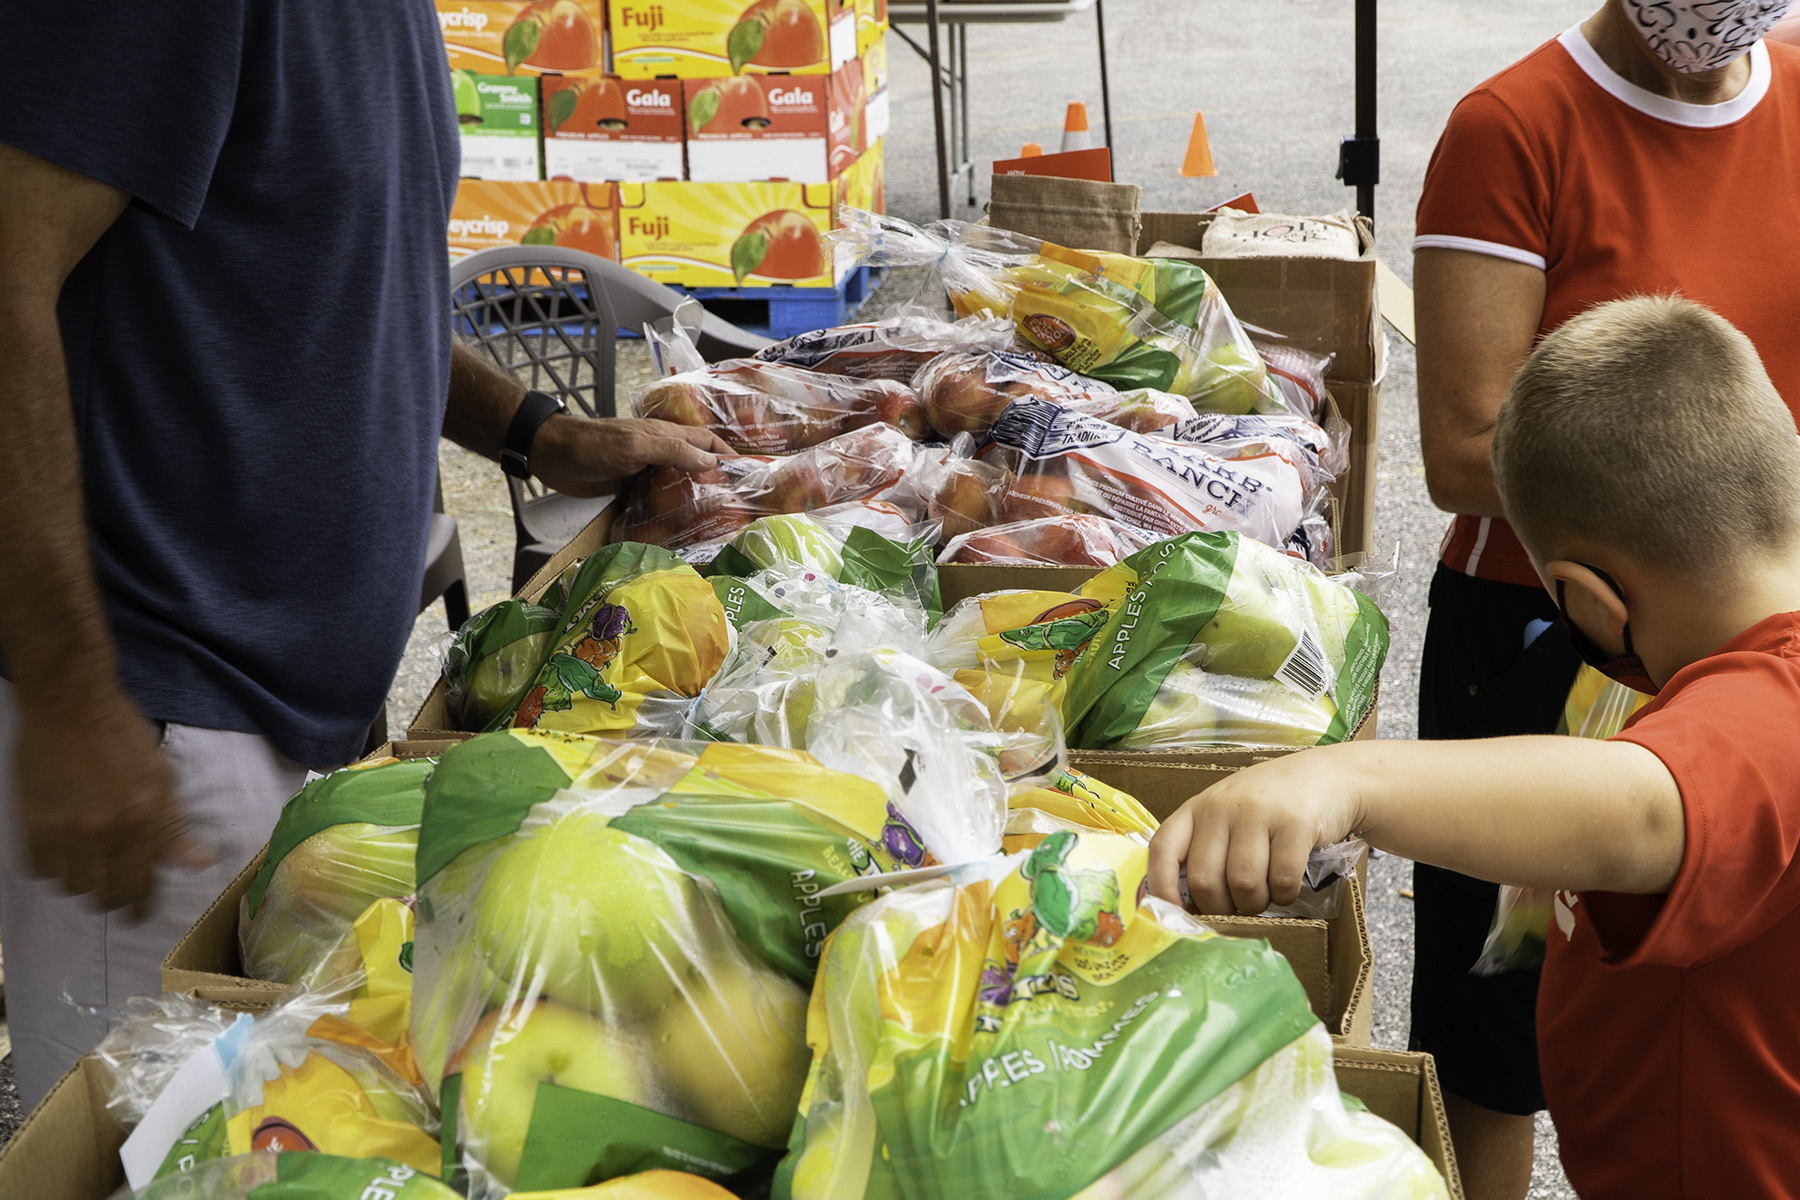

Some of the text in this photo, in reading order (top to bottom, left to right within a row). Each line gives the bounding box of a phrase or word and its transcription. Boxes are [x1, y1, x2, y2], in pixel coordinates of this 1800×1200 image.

[622, 6, 663, 31] Fuji
[626, 89, 671, 107] Gala
[768, 87, 813, 105] Gala
[629, 216, 669, 241] Fuji
[1062, 431, 1110, 445] TRADITION
[1108, 590, 1147, 671] APPLES
[847, 837, 866, 863] THE
[790, 869, 827, 958] APPLES
